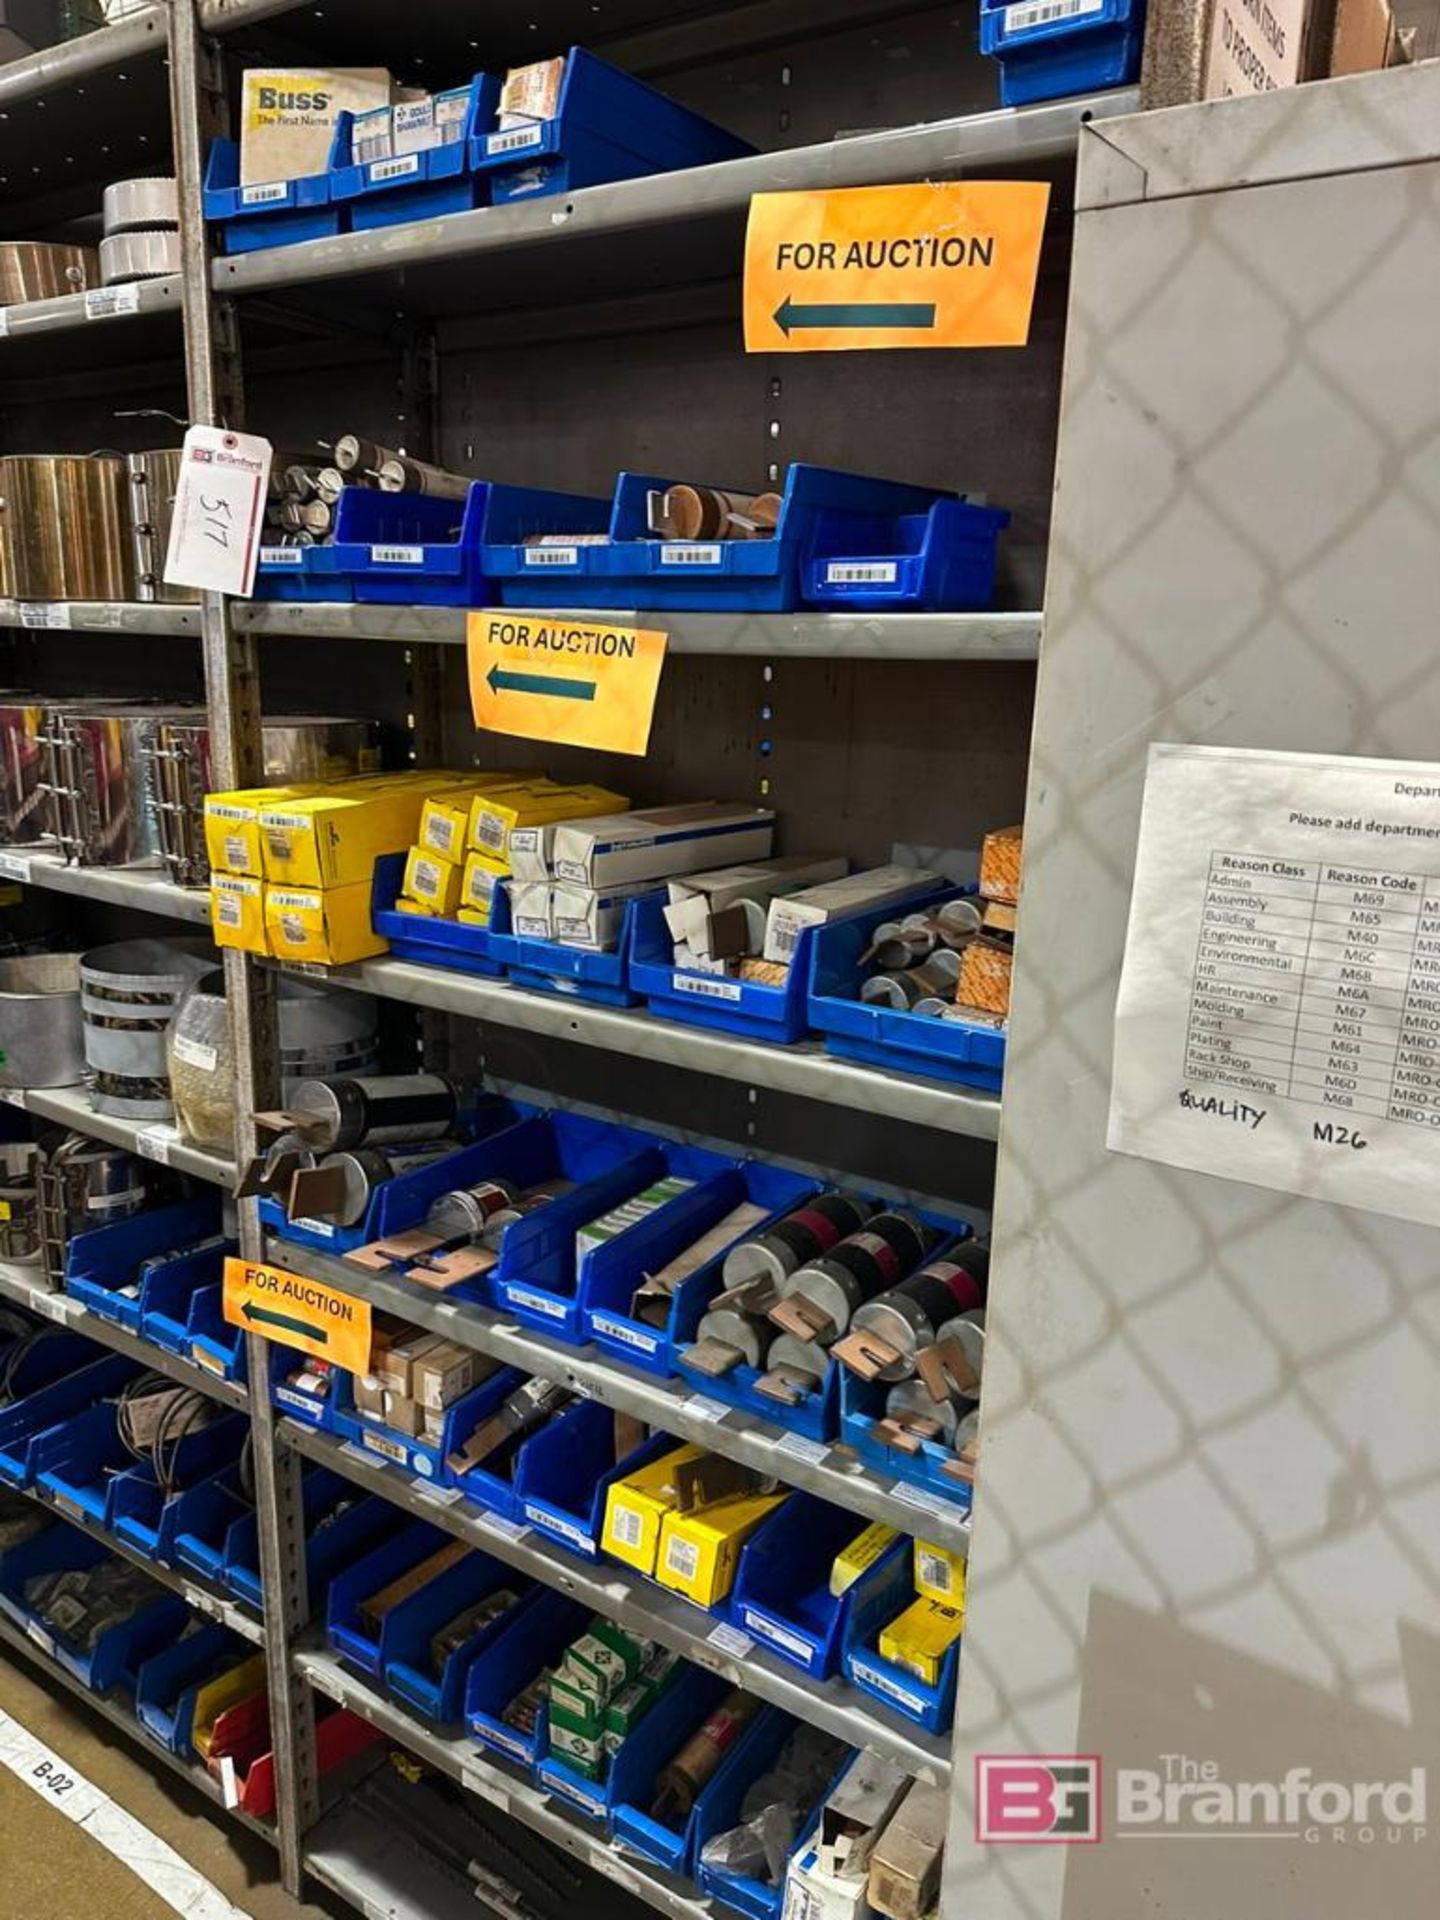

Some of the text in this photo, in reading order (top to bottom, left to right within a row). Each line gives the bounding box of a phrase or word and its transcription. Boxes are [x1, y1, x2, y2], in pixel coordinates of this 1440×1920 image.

[1221, 7, 1234, 50] TO
[1231, 28, 1266, 91] PROPER
[259, 87, 329, 111] Buss
[258, 113, 275, 125] The
[278, 115, 299, 126] First
[301, 116, 329, 127] Name
[776, 237, 994, 270] FOR AUCTION
[200, 494, 233, 548] 517
[487, 622, 636, 658] FOR AUCTION
[1289, 812, 1332, 829] Please
[1335, 818, 1362, 831] add
[1211, 874, 1252, 889] Admin
[1353, 891, 1385, 906] M69
[1222, 857, 1417, 891] Reason Class Reason Code
[1207, 892, 1268, 912] Assembly
[1350, 910, 1382, 926] M65
[1205, 910, 1256, 930] Building
[1347, 929, 1379, 945] M40
[1201, 946, 1293, 970] Environmental
[1203, 928, 1277, 952] Engineering
[1344, 948, 1376, 964] M6C
[1195, 980, 1278, 1005] Maintenance
[1334, 1003, 1367, 1019] M67
[1198, 964, 1217, 978] HR
[1338, 985, 1370, 1001] M6A
[1191, 1014, 1223, 1031] Paint
[1330, 1040, 1361, 1055] M64
[1194, 998, 1245, 1019] Molding
[1332, 1022, 1363, 1037] M61
[1188, 1048, 1216, 1063] Rack
[1219, 1053, 1252, 1071] Shop
[1190, 1031, 1232, 1051] Plating
[1328, 1057, 1359, 1073] M63
[1186, 1065, 1278, 1094] Ship/Receiving
[1179, 1088, 1368, 1149] QUALITY M26
[244, 1268, 353, 1321] FOR AUCTION
[33, 1761, 74, 1795] B-02
